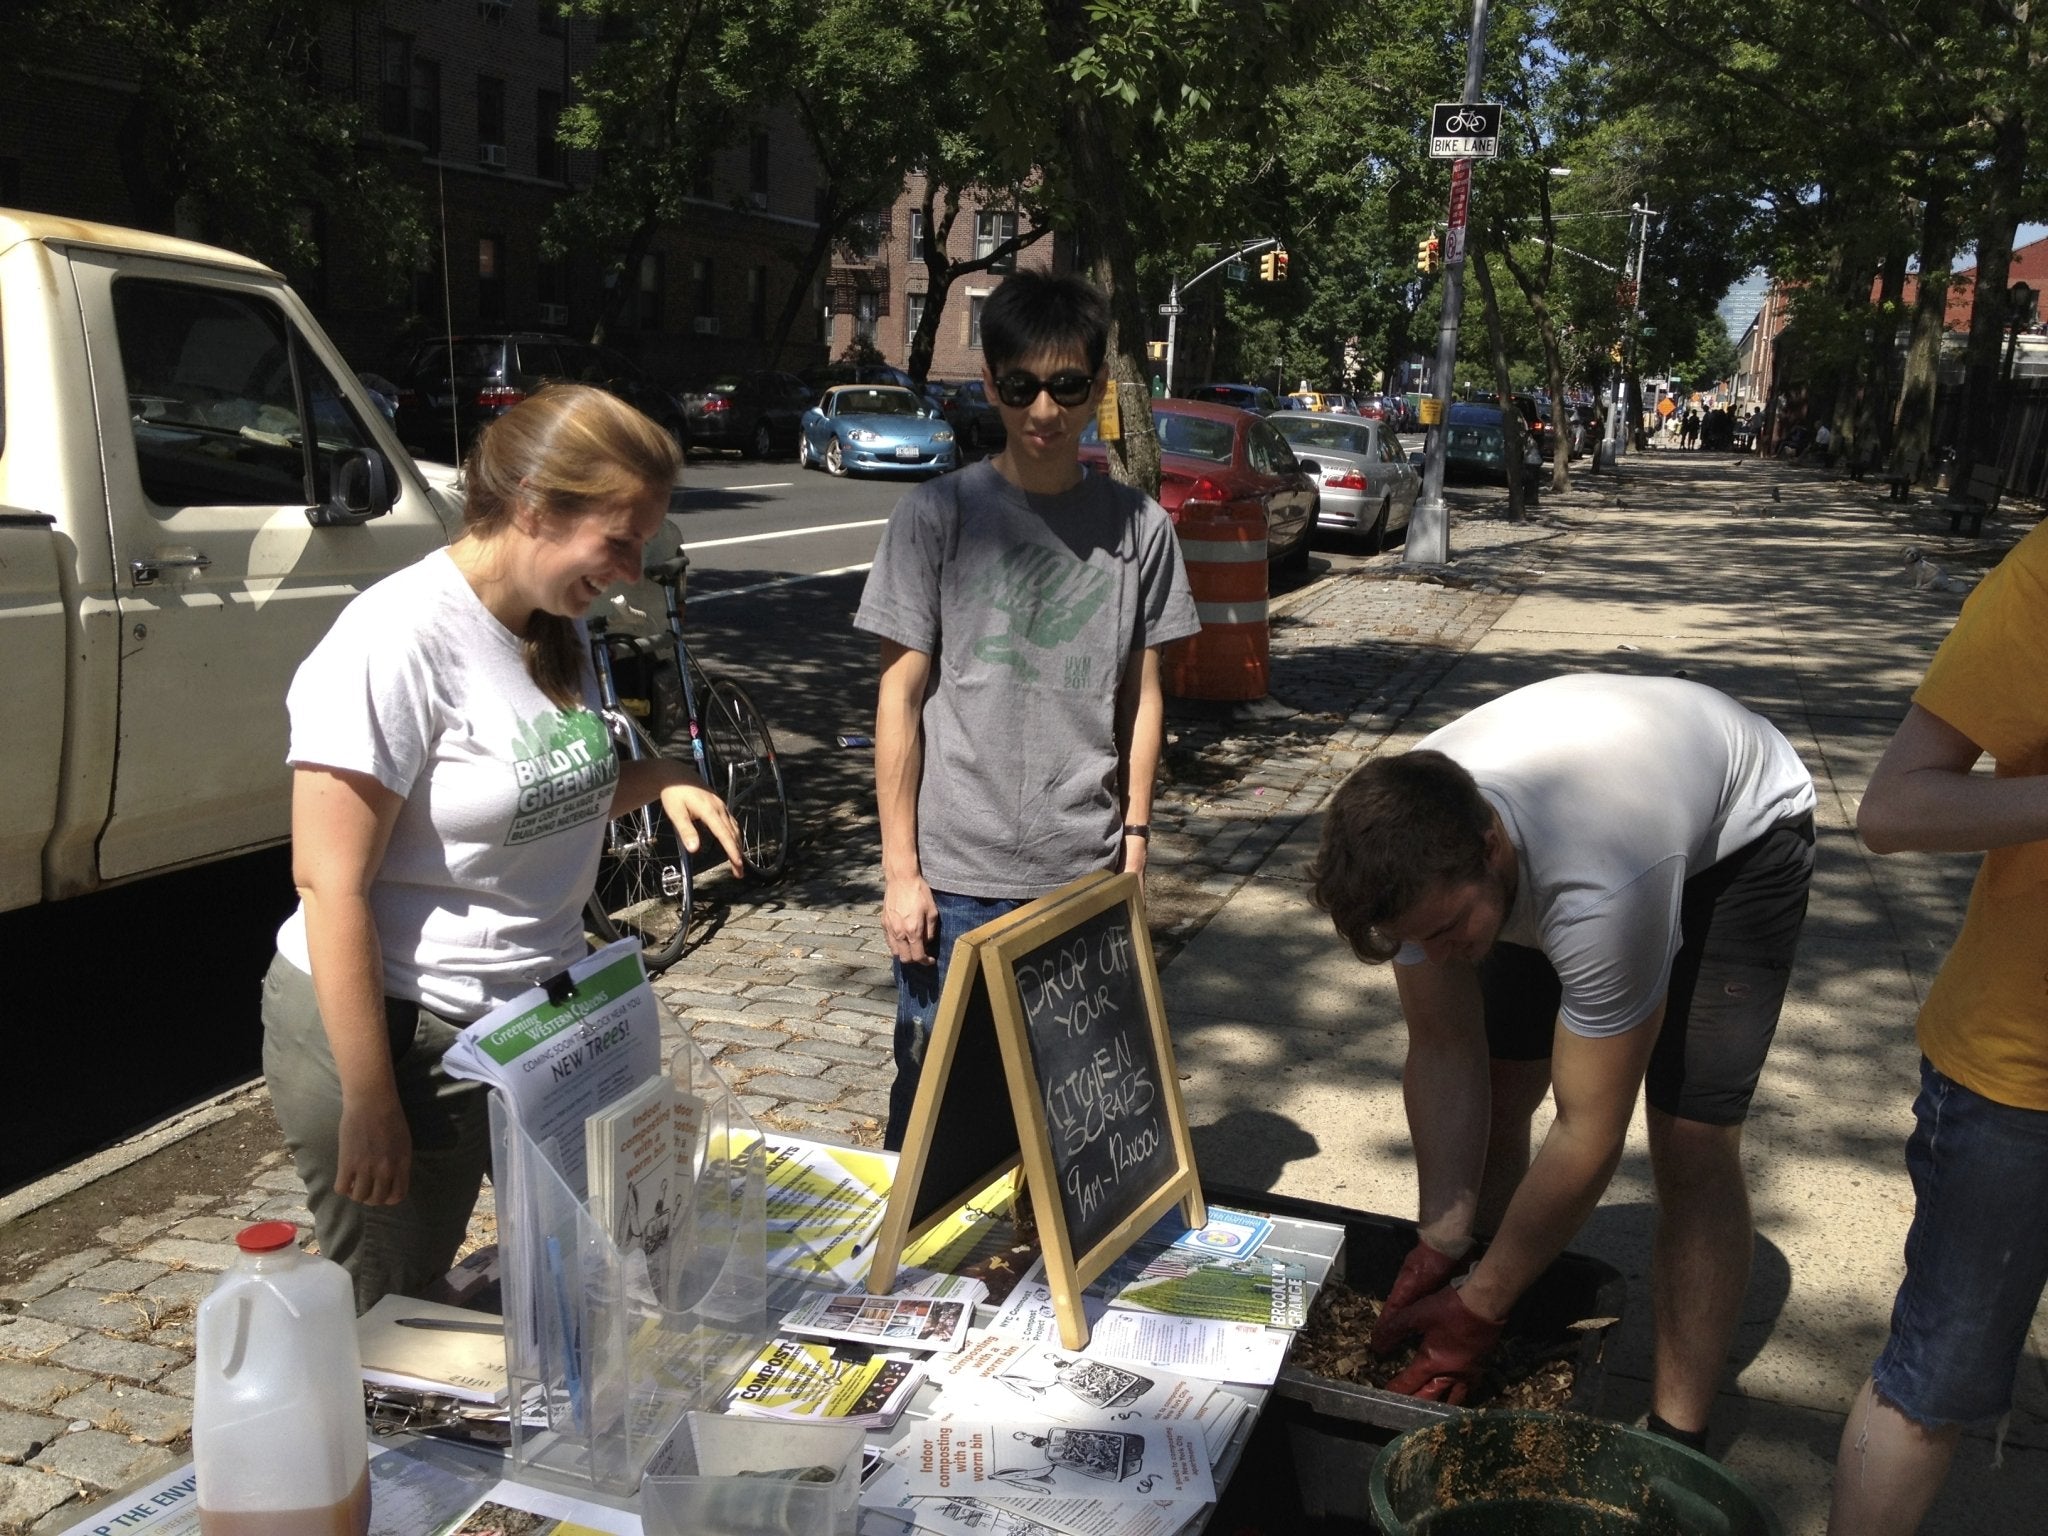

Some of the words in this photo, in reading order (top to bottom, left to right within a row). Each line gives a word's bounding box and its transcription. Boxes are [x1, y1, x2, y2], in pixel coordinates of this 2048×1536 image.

[1434, 139, 1459, 152] BIKE
[1464, 139, 1494, 152] LANE
[514, 749, 572, 789] BUILD
[565, 739, 592, 765] IT
[511, 821, 556, 841] BUILDING
[556, 803, 601, 826] MATERIALS
[515, 815, 537, 830] LOW
[1015, 937, 1088, 1026] DROP
[1099, 925, 1129, 978] OFF
[490, 1012, 540, 1045] Greening
[524, 1010, 575, 1042] WESTERN
[1053, 985, 1120, 1038] YOUR
[522, 1048, 554, 1073] COMING
[552, 1037, 575, 1056] SOON
[550, 1047, 584, 1083] NEW
[1046, 1030, 1132, 1131] KITCHEN
[633, 1100, 662, 1128] Indoor
[1063, 1066, 1155, 1157] SCRAPS
[620, 1108, 670, 1153] composting
[633, 1138, 653, 1159] with
[626, 1154, 652, 1180] worm
[654, 1142, 666, 1158] bin
[1000, 1315, 1014, 1328] NYC
[1009, 1290, 1033, 1317] Compost
[1271, 1263, 1287, 1325] BROOKLYN
[1288, 1278, 1305, 1327] GRANGE
[1023, 1309, 1038, 1336] Compost
[1032, 1319, 1046, 1341] Project
[943, 1339, 973, 1361] Inor
[948, 1335, 999, 1376] composting
[973, 1353, 994, 1369] with
[979, 1357, 1007, 1378] worm
[1000, 1346, 1019, 1358] bin
[740, 1342, 797, 1401] COMPOST
[920, 1439, 933, 1473] Indoor
[937, 1428, 952, 1488] composting
[969, 1434, 983, 1449] bin
[953, 1450, 967, 1473] with
[973, 1452, 984, 1482] worm
[110, 1503, 159, 1527] THE
[150, 1475, 196, 1507] ENV
